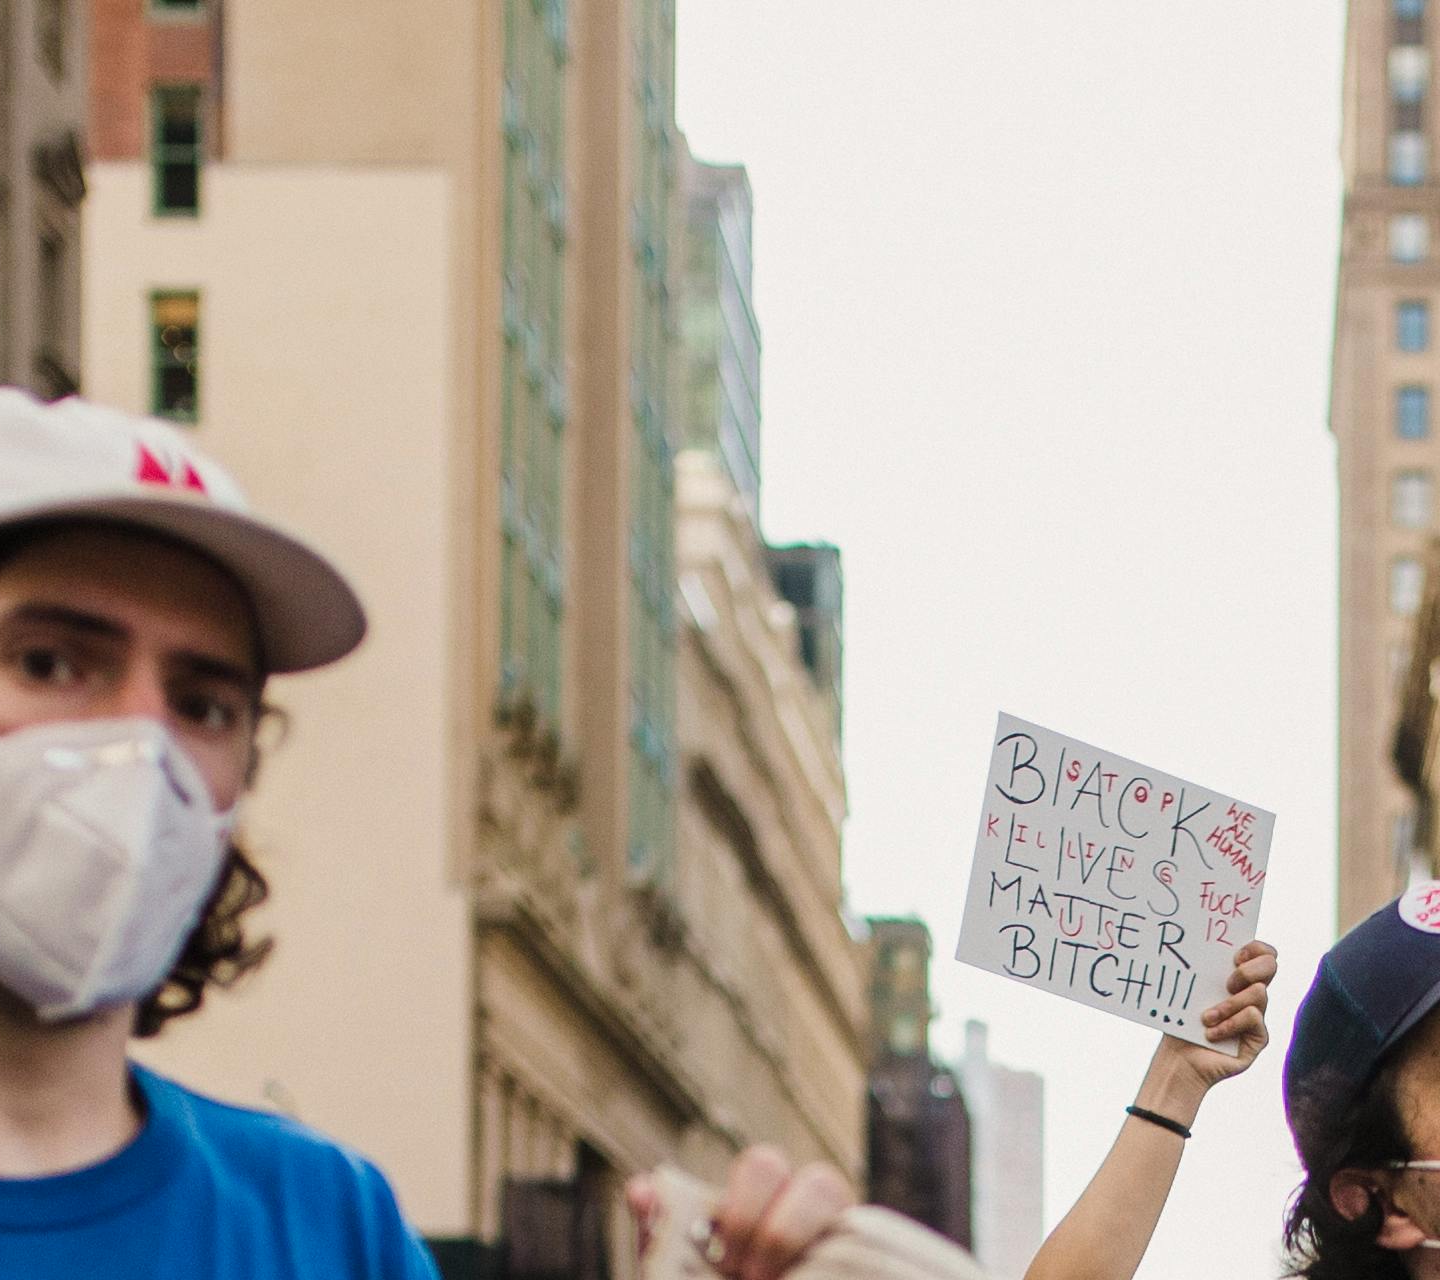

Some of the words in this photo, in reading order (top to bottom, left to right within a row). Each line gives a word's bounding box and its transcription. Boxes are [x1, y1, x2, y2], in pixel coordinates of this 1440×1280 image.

[1227, 803, 1256, 827] WE
[1005, 812, 1180, 917] LIVES
[1199, 881, 1251, 918] FUCK
[989, 871, 1191, 969] MATTER
[1206, 917, 1234, 946] 12
